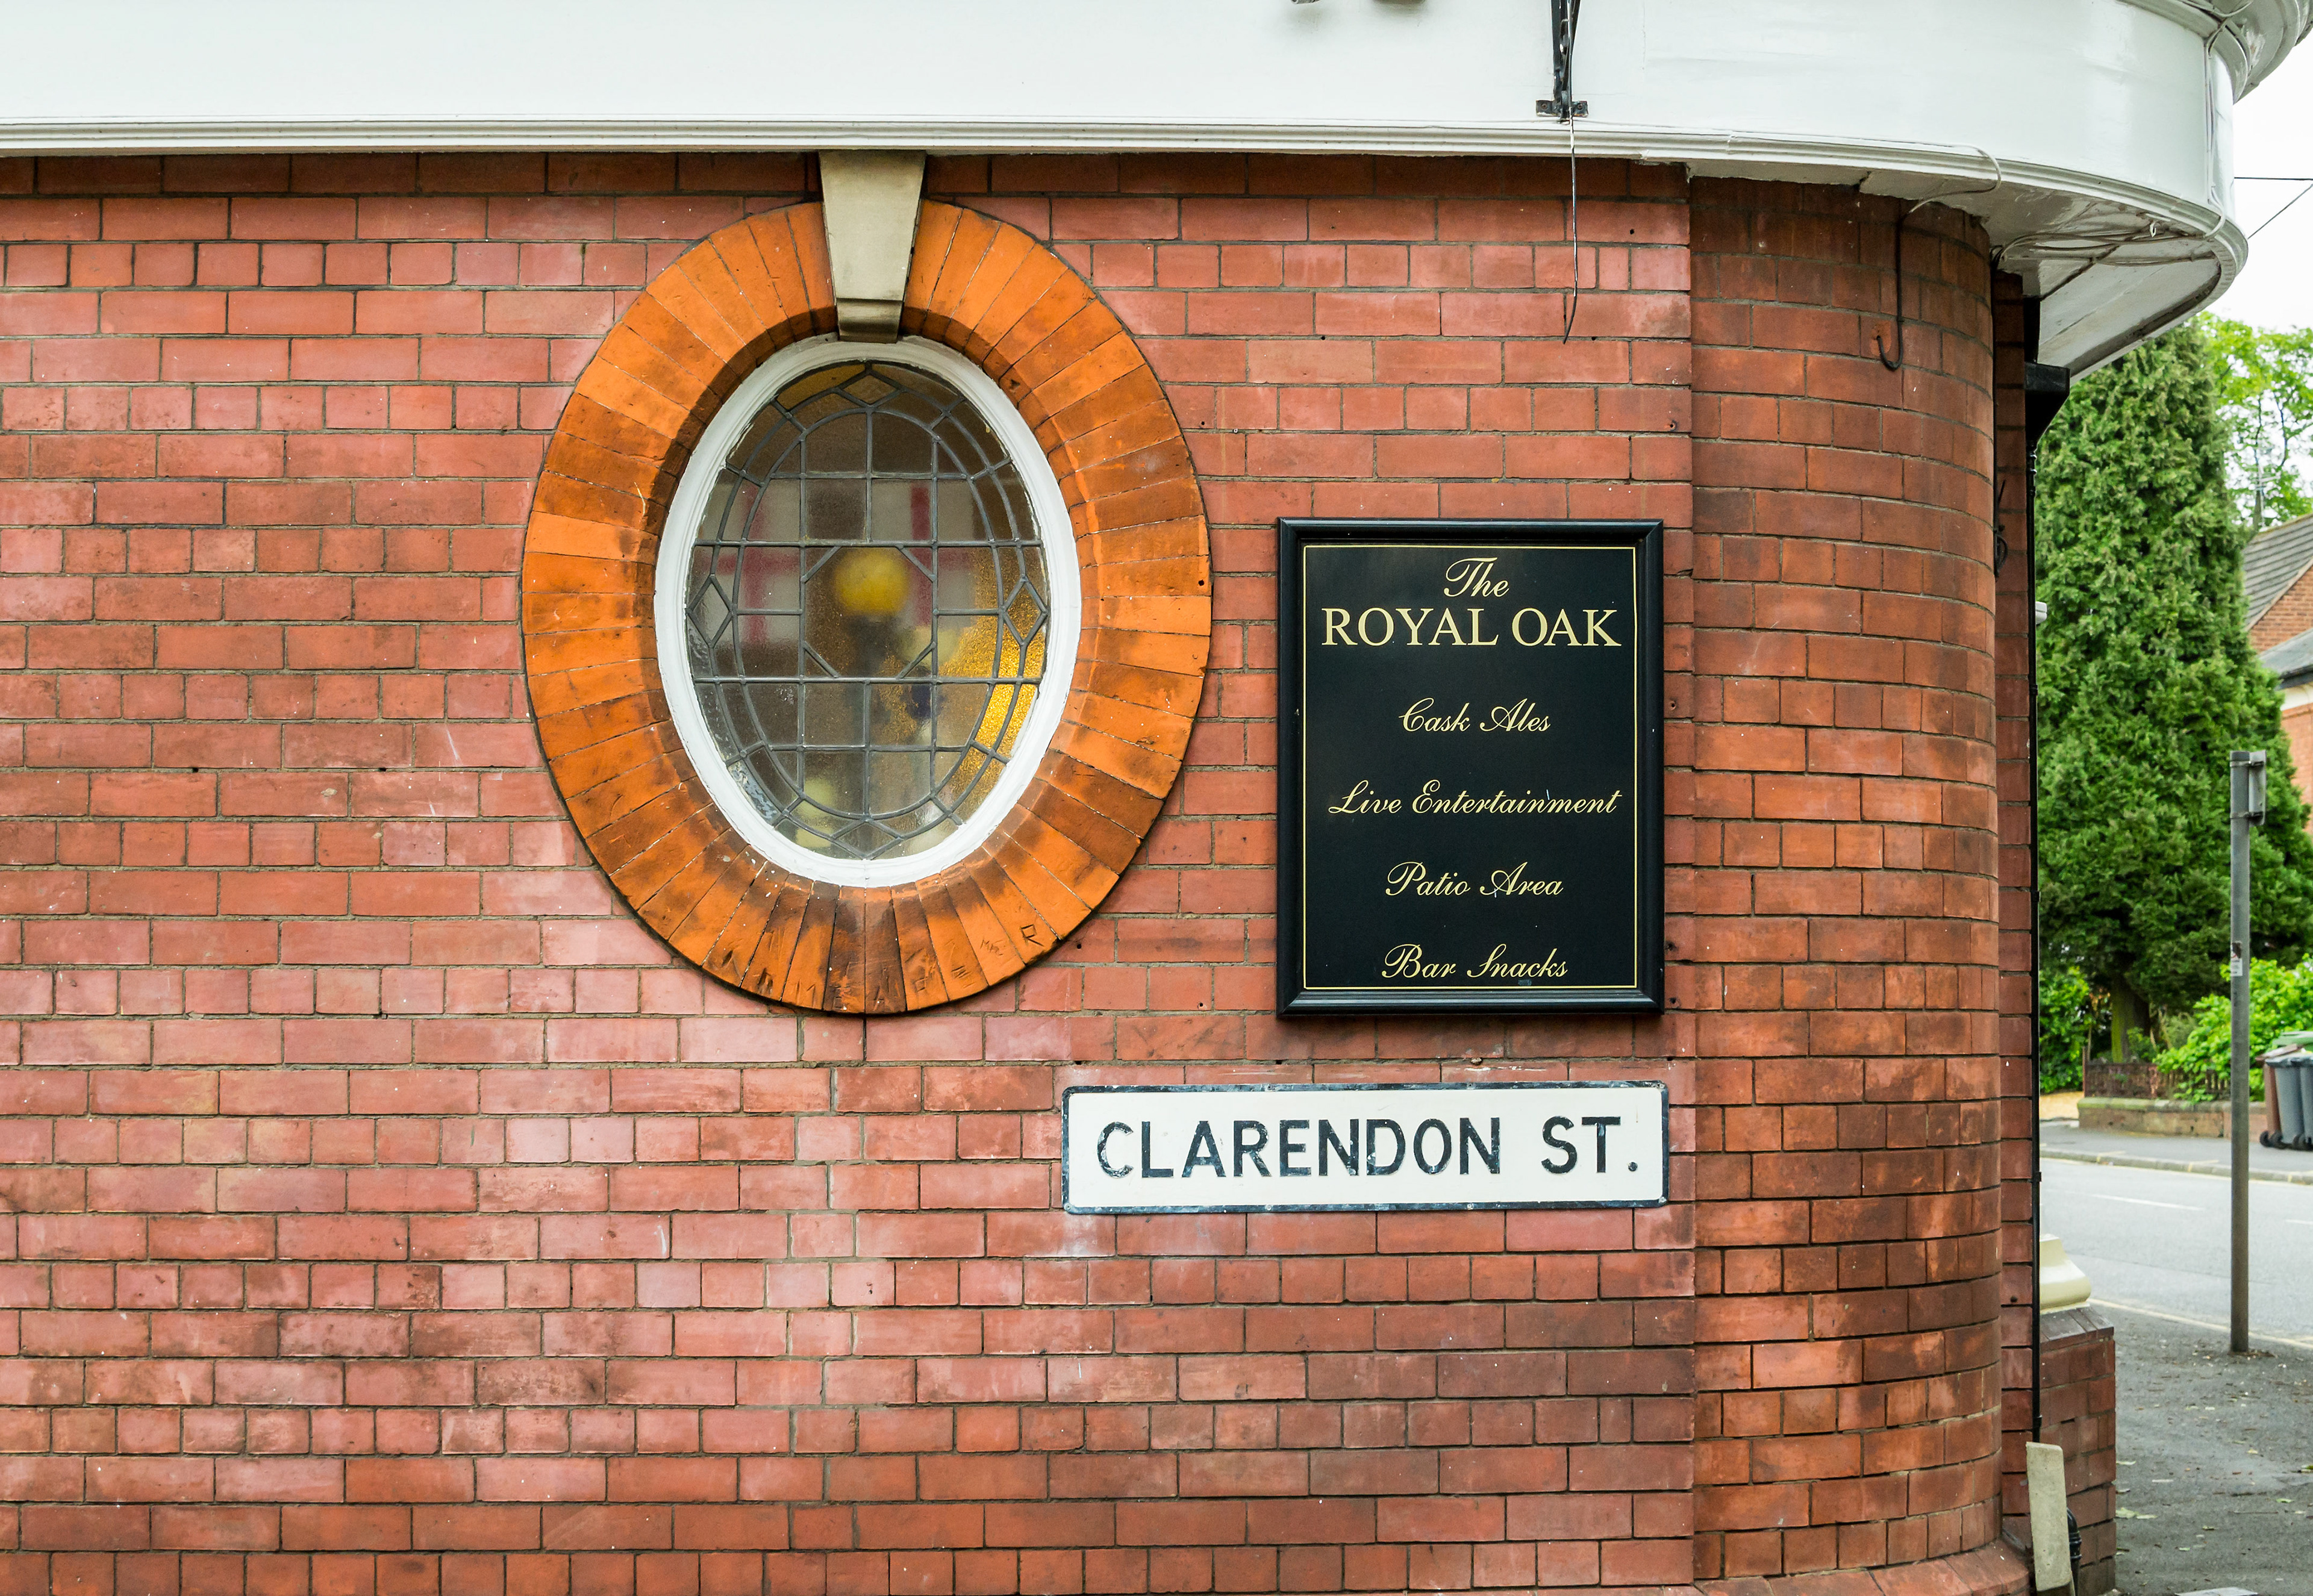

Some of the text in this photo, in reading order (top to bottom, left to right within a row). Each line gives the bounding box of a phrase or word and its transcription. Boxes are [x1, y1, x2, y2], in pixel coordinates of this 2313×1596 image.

[1443, 557, 1508, 597] The
[1322, 607, 1621, 646] ROYAL OAK
[1399, 697, 1550, 732] Cask Ales
[1328, 779, 1623, 814] Live Entertainment
[1385, 861, 1562, 896] Patio Area
[1381, 943, 1568, 978] Bar Snacks
[1097, 1116, 1638, 1178] CLARENDON ST.
